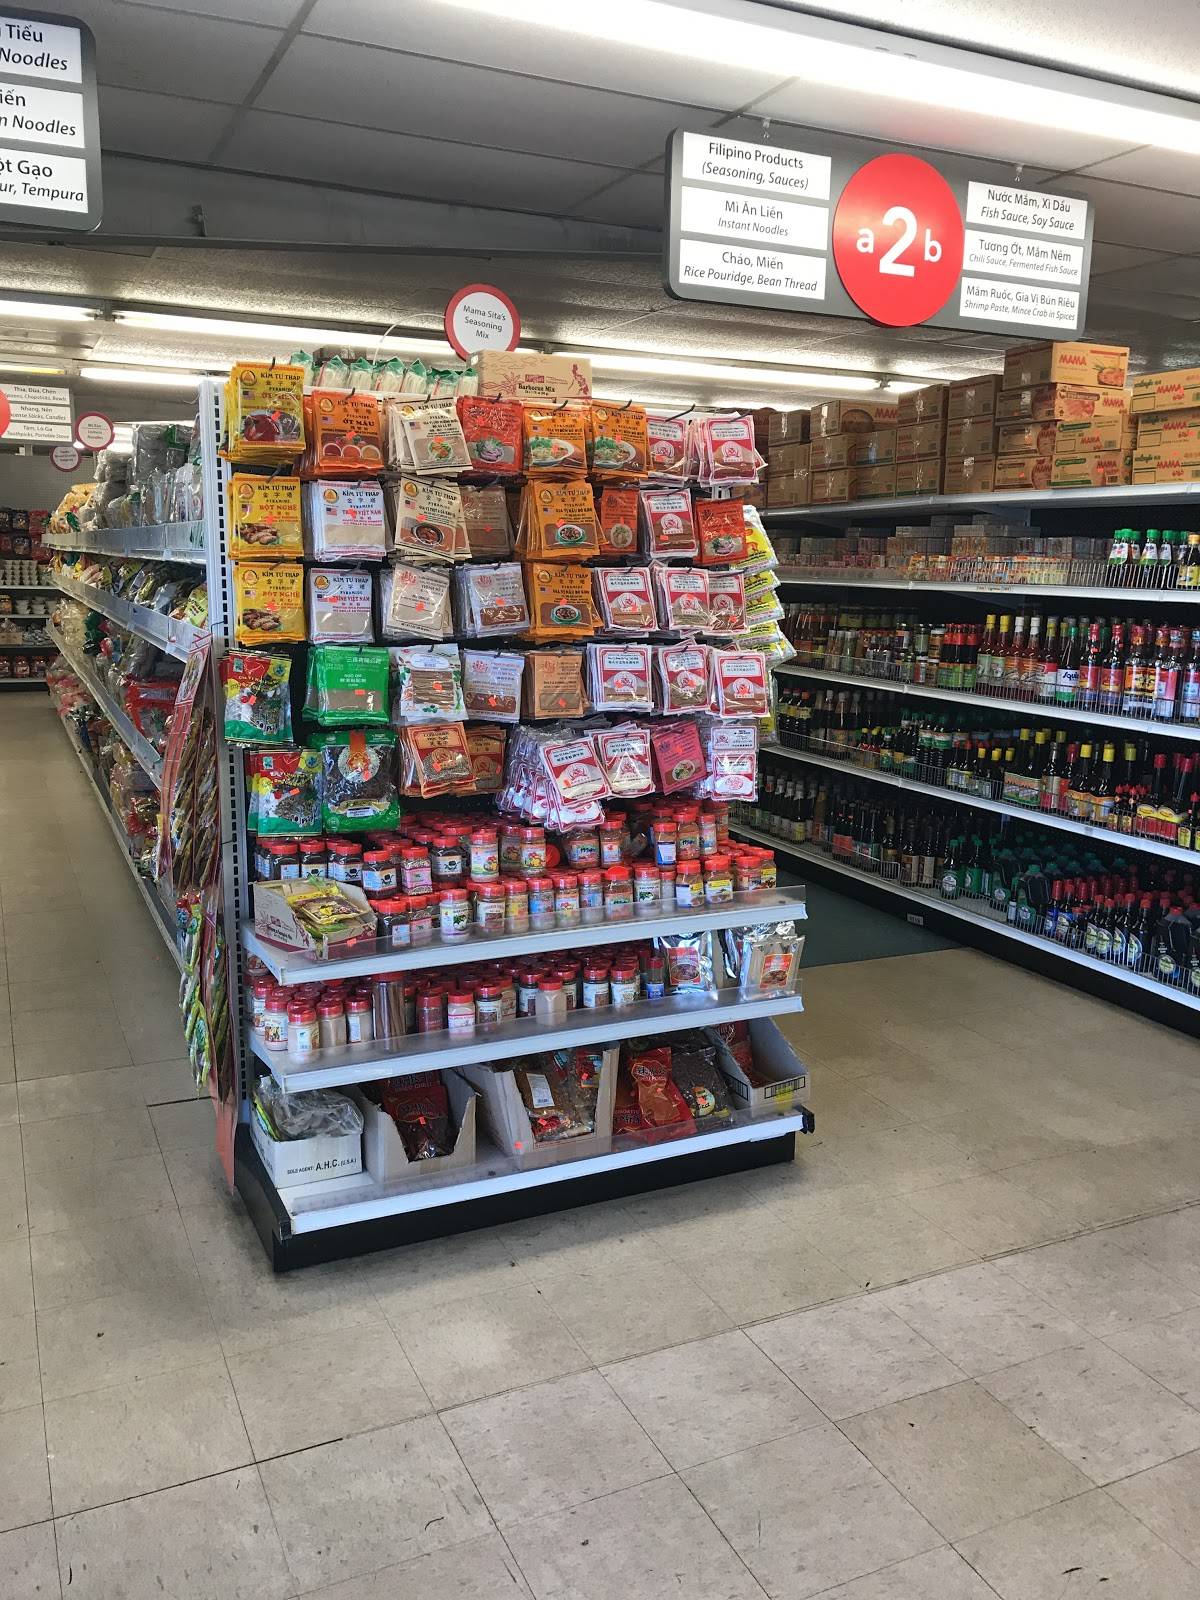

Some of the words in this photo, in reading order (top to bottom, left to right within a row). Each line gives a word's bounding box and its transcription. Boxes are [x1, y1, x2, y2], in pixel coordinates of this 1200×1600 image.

[0, 47, 67, 70] Noodles
[12, 115, 76, 136] Noodles
[709, 142, 751, 160] Filipino
[754, 150, 804, 169] Products
[17, 160, 53, 180] Gạo
[702, 161, 765, 184] (Seasoning,
[768, 172, 809, 190] Sauces)
[21, 182, 84, 201] Tempura
[718, 217, 750, 231] Instant
[752, 222, 789, 236] Noodles
[981, 206, 999, 219] Fish
[1001, 209, 1030, 225] Sauce,
[1032, 214, 1048, 229] Soy
[1049, 217, 1074, 230] Sauce
[856, 228, 874, 253] a
[879, 206, 917, 277] 2
[924, 228, 942, 262] b
[969, 253, 985, 263] Chili
[986, 255, 1008, 267] Sauce,
[1009, 259, 1044, 271] Fermented
[1045, 264, 1058, 273] Fish
[1059, 265, 1078, 276] Sauce
[684, 266, 705, 278] Rice
[707, 267, 755, 285] Pouridge,
[757, 274, 782, 287] Bean
[784, 278, 817, 291] Thread
[1015, 292, 1029, 303] Gia
[463, 304, 486, 316] Mama
[487, 310, 506, 321] Sita's
[965, 300, 989, 312] Shrimp
[990, 303, 1010, 314] Paste,
[1011, 305, 1032, 316] Mince
[1032, 307, 1048, 317] Crab
[1048, 309, 1055, 318] in
[1056, 311, 1075, 321] Spices
[464, 317, 503, 332] Seasoning
[475, 330, 489, 339] Mix
[1058, 354, 1087, 366] MAMA
[1103, 397, 1124, 407] MAMA
[874, 408, 897, 418] MAM
[1162, 421, 1187, 431] MAMA
[1097, 460, 1117, 469] MAMA
[1157, 460, 1180, 469] MAMA
[315, 1159, 340, 1171] A.H.C.
